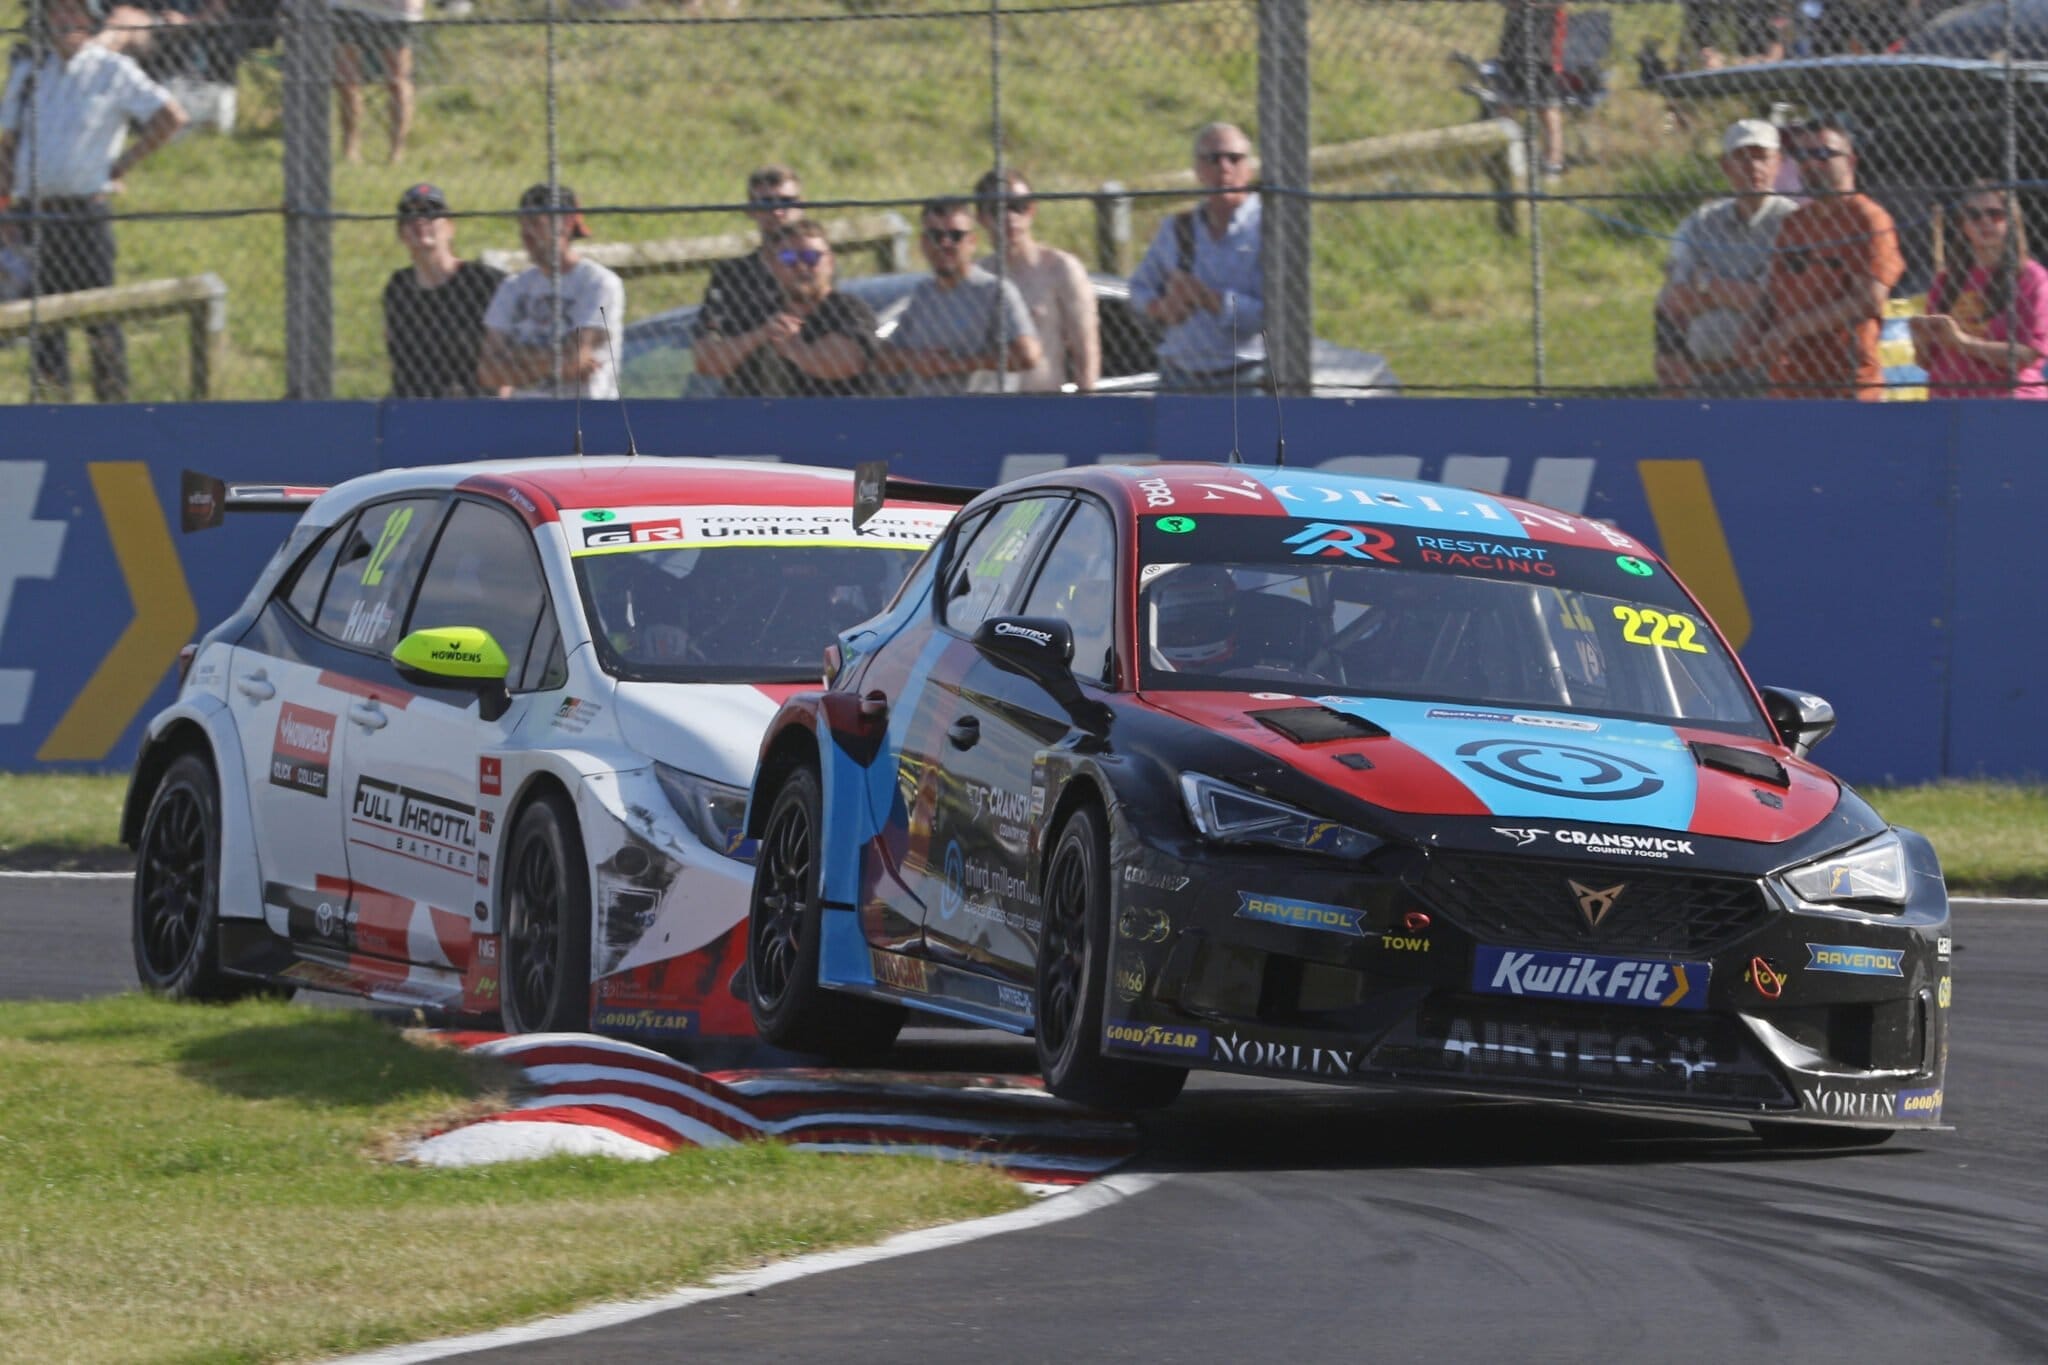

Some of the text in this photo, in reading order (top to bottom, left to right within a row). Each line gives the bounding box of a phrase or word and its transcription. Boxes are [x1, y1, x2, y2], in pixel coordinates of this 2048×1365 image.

[696, 516, 804, 524] TOYOTA
[812, 516, 905, 525] GAOO
[701, 526, 830, 538] United
[361, 507, 414, 586] 12
[1416, 535, 1548, 561] RESTART
[1420, 550, 1557, 577] RACING
[1612, 605, 1708, 654] 222
[431, 650, 482, 663] HOWDENS
[353, 777, 397, 824] FULL
[1554, 829, 1695, 856] CRANSWICK
[1586, 845, 1669, 859] COUNTRY FOODS
[1248, 899, 1353, 928] RAVENOL
[1382, 935, 1420, 951] TOW
[1816, 951, 1896, 970] RAVENOL
[1213, 1031, 1353, 1075] NORLIN
[1802, 1081, 1897, 1117] NORLIN
